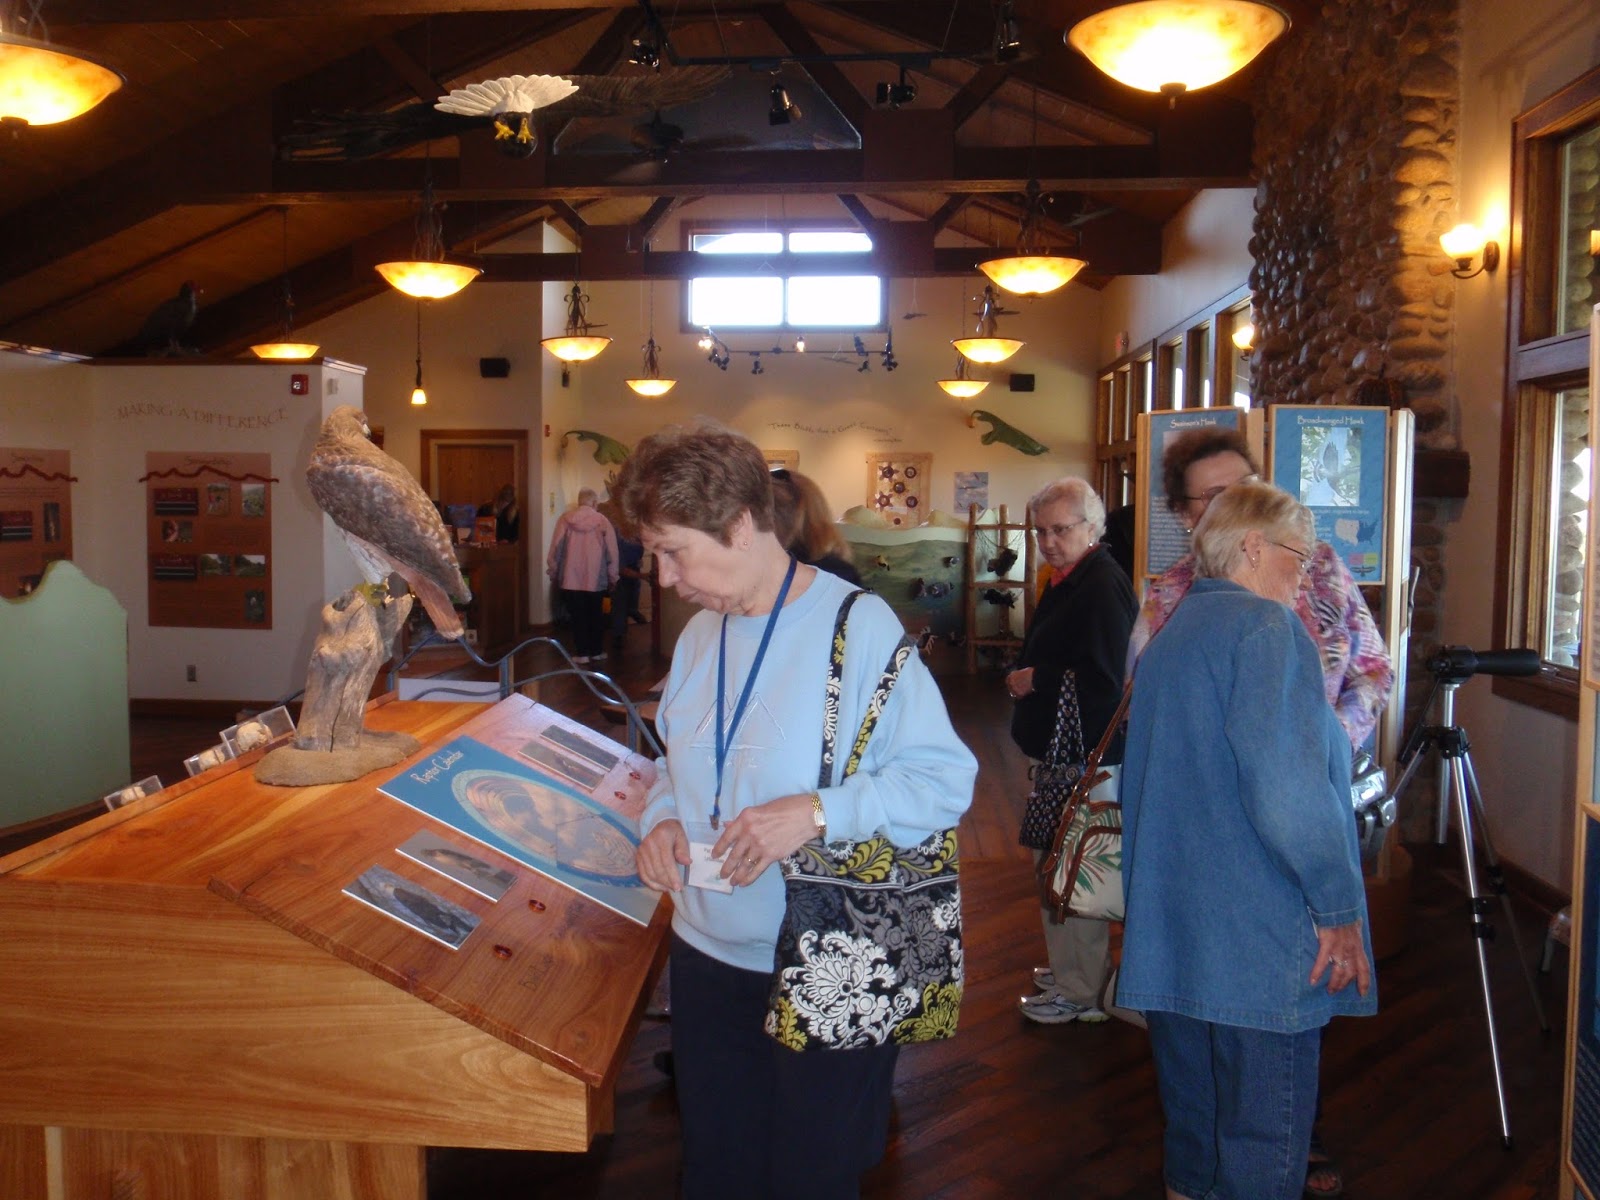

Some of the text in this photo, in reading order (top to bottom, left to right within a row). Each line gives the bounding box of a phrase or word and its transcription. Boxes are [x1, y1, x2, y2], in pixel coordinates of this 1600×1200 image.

[117, 402, 288, 428] MAKING A DIFFERENCE
[1200, 417, 1217, 426] Hawk
[1345, 416, 1365, 425] Hawk
[410, 767, 440, 785] Raptor
